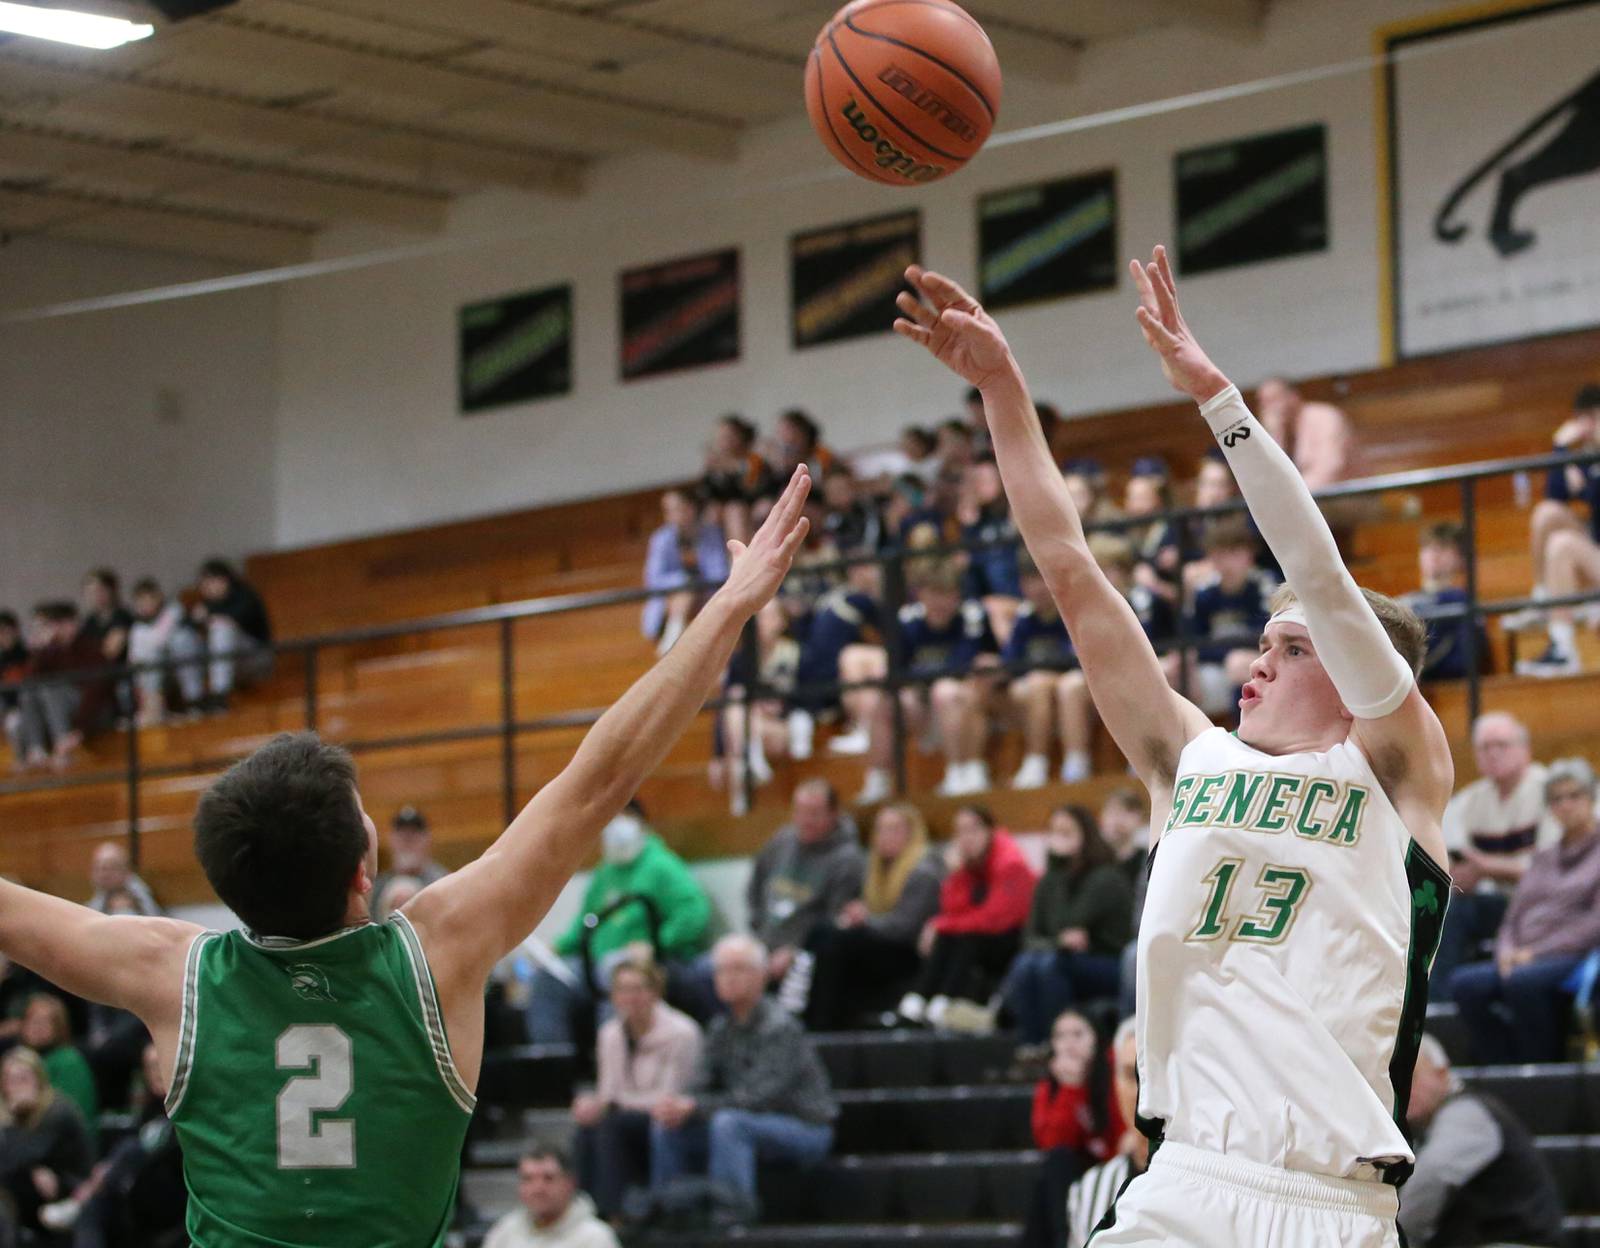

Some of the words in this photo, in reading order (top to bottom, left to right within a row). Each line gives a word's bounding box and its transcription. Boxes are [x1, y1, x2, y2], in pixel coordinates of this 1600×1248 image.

[841, 96, 944, 183] Wilson
[1165, 769, 1370, 847] SENECA
[1183, 857, 1313, 945] 13
[275, 1023, 356, 1169] 2
